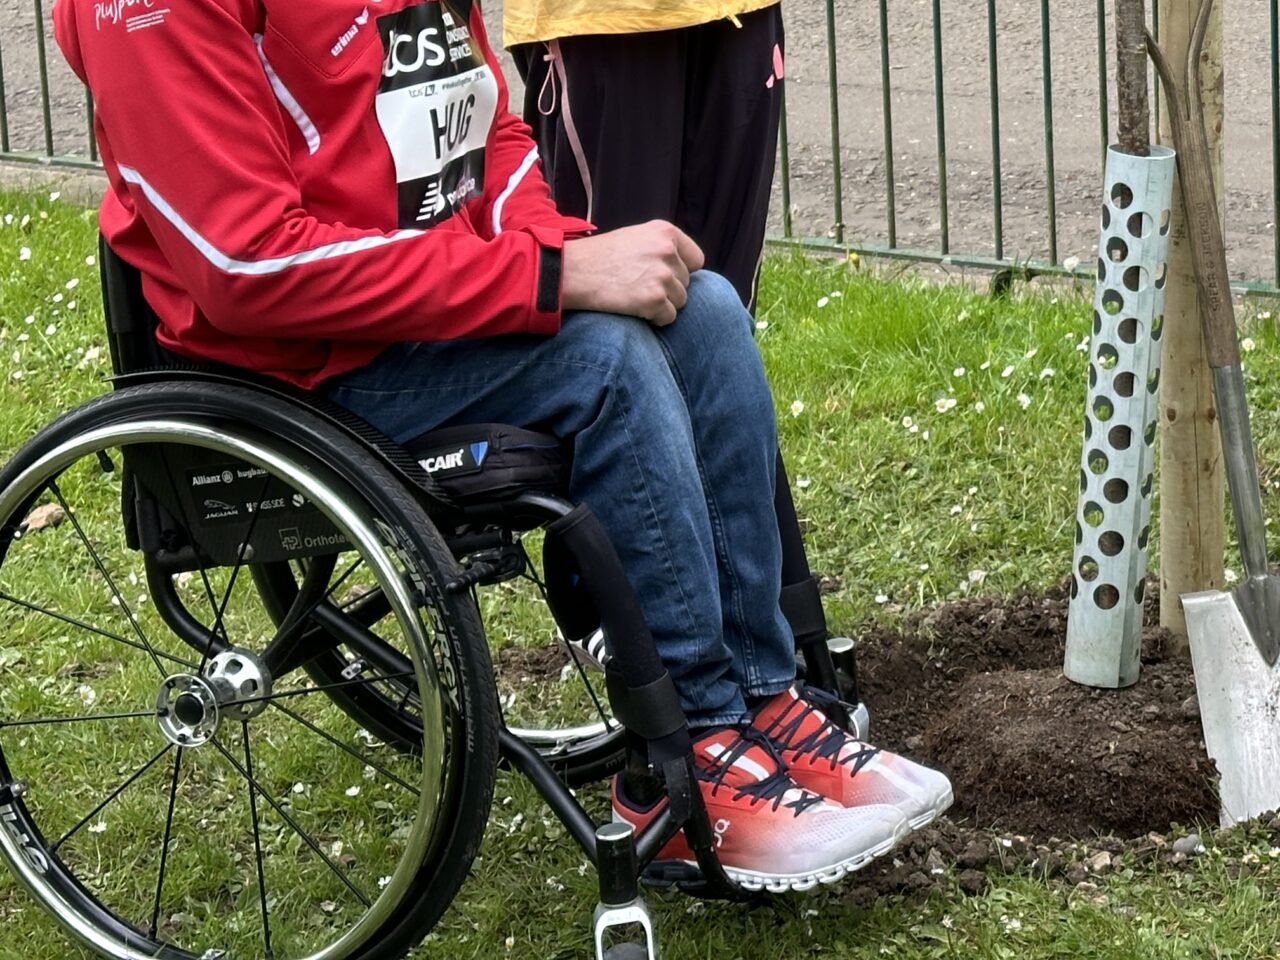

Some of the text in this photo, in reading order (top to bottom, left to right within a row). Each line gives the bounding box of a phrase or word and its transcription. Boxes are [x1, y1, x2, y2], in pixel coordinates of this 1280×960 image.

[331, 24, 359, 57] erima
[382, 27, 446, 78] tcs
[429, 93, 476, 160] HUG
[192, 474, 221, 486] Allianz
